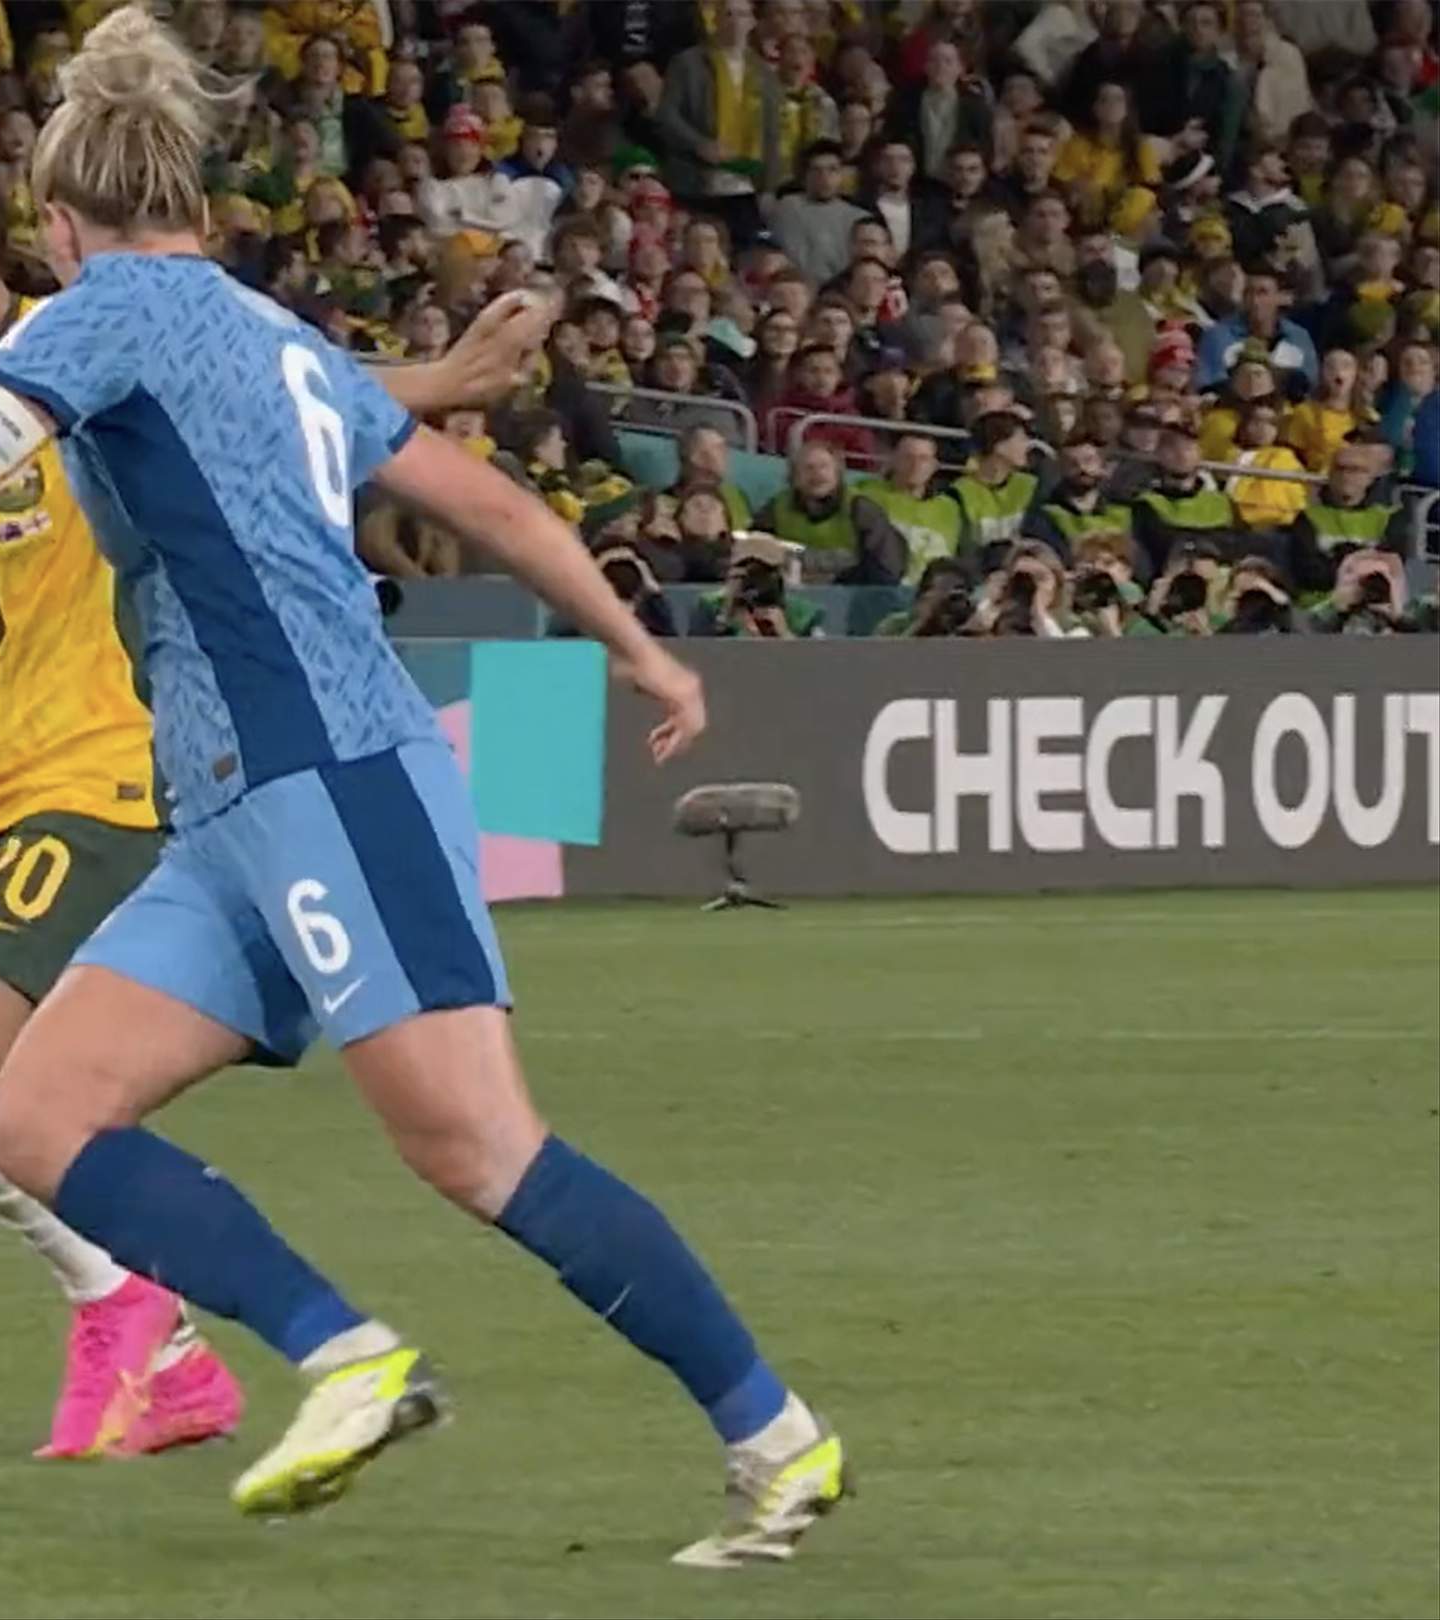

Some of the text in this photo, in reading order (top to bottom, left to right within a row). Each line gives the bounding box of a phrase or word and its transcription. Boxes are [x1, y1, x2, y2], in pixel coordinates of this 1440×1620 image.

[281, 341, 349, 528] 6
[863, 695, 1229, 853] CHECK
[287, 878, 352, 974] 6
